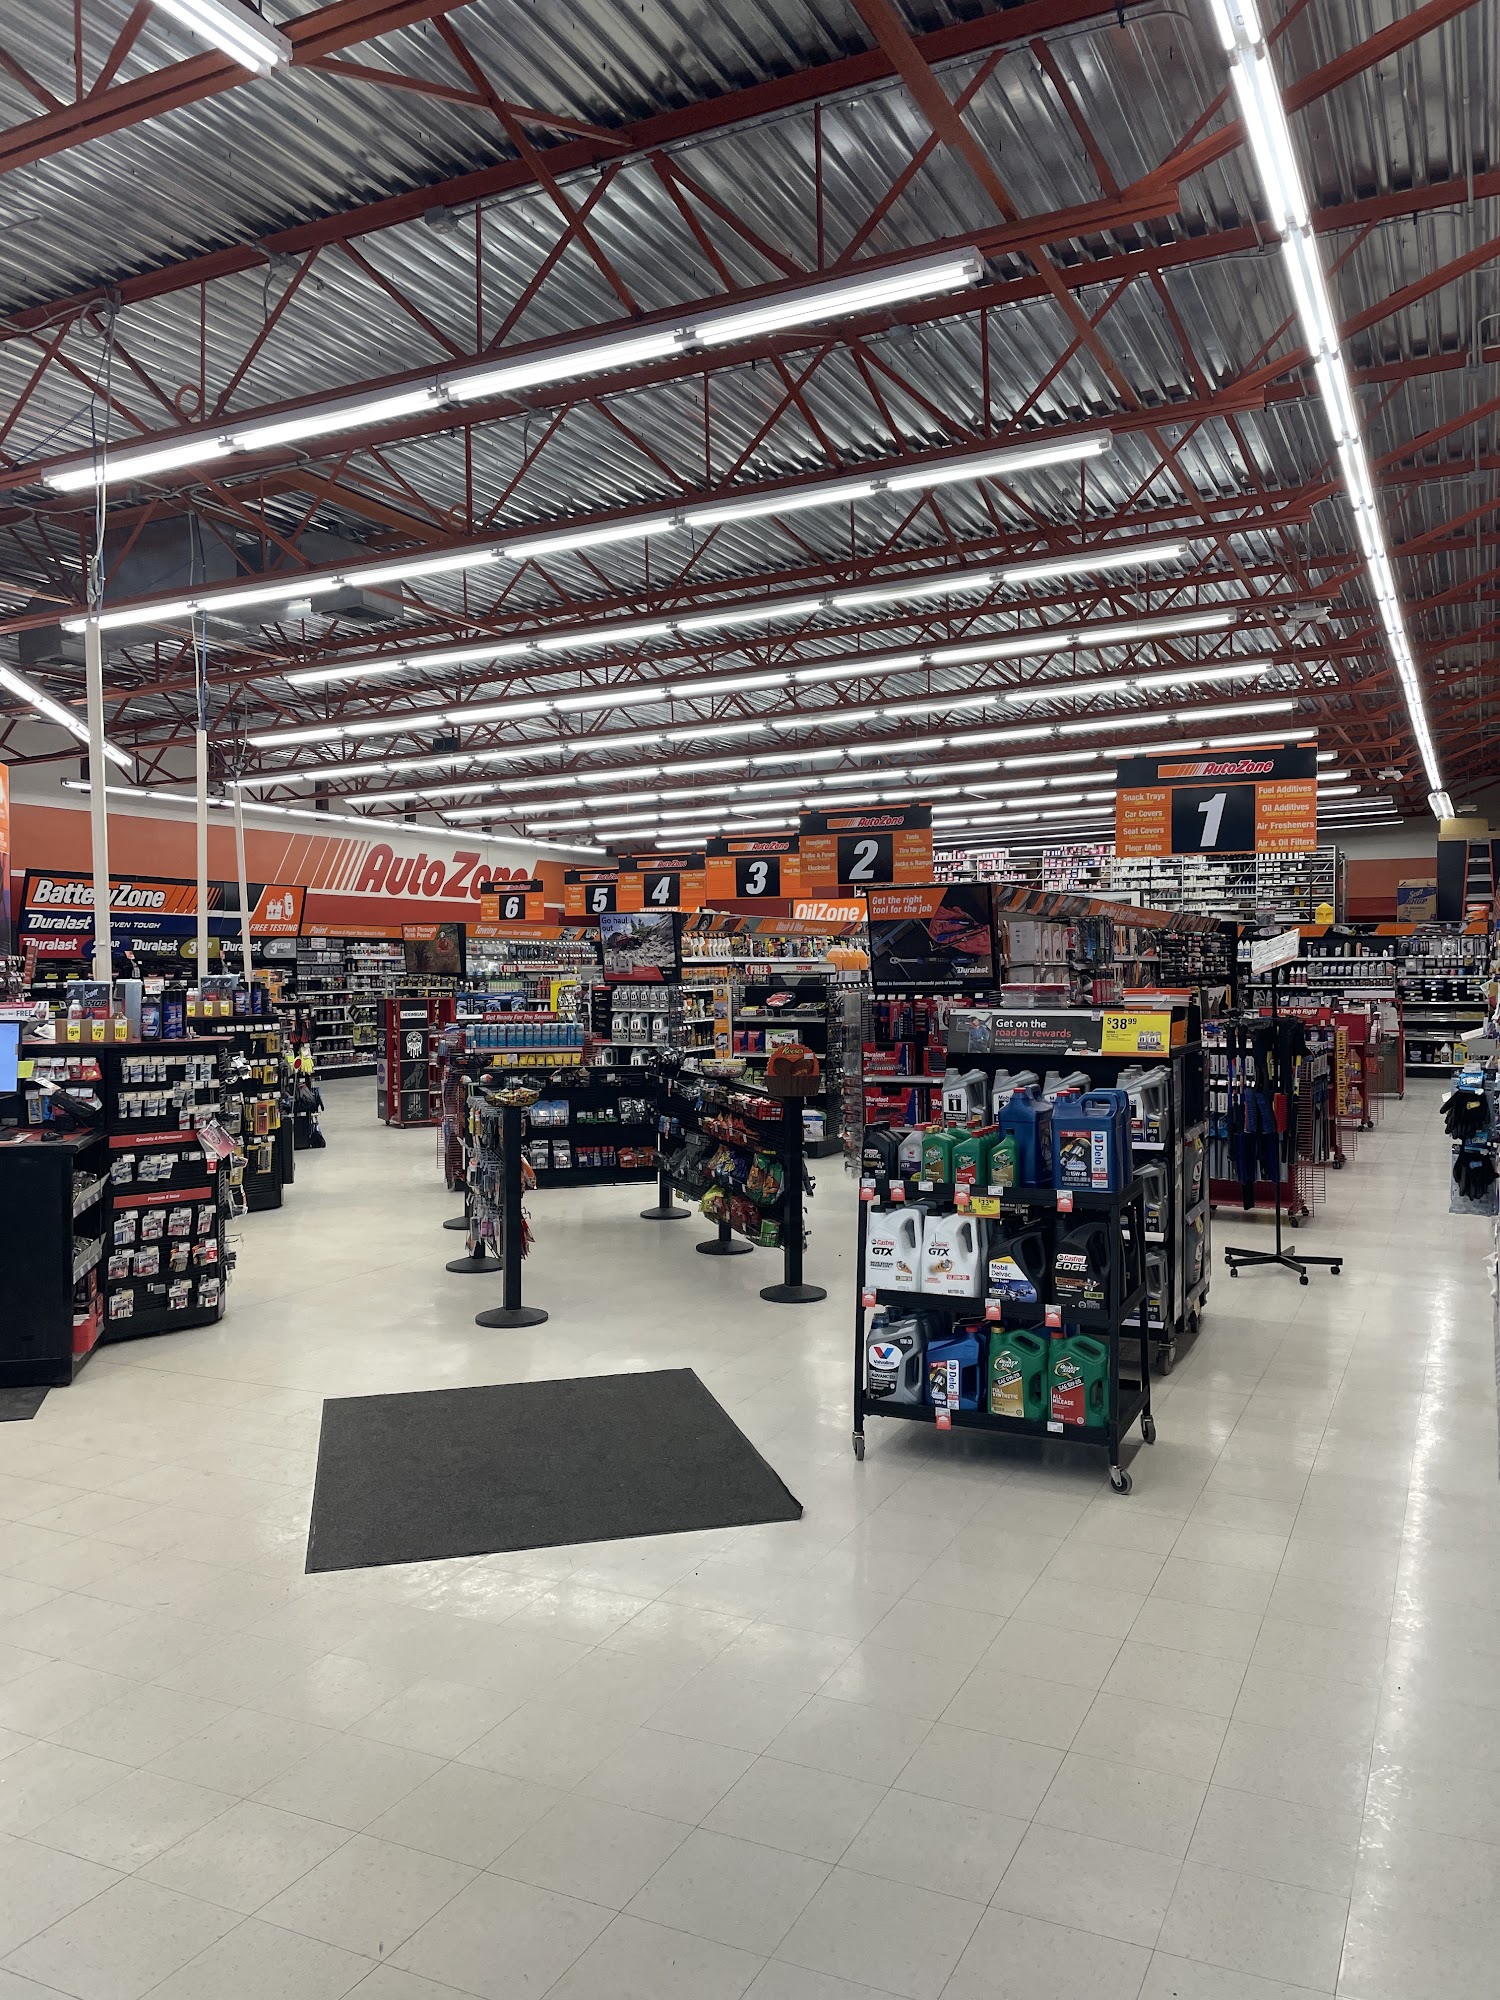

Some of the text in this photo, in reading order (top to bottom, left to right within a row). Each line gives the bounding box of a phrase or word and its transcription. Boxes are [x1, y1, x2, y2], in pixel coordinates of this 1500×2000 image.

[1203, 760, 1274, 776] AutoZone
[1258, 785, 1312, 794] Fuel Additives
[1146, 793, 1166, 801] Trays
[1262, 803, 1309, 812] Oil Additives
[1125, 810, 1137, 818] Car
[858, 815, 904, 827] AutoZone
[1198, 793, 1226, 847] 1
[1257, 821, 1314, 830] Air Fresheners
[1123, 827, 1164, 835] Seat Covers
[752, 842, 789, 850] AutoZone
[1125, 843, 1162, 852] Floor Mats
[1257, 839, 1269, 847] Air
[1278, 838, 1289, 846] Oil
[1291, 838, 1315, 846] Filters
[849, 840, 879, 880] 2
[746, 861, 768, 894] 3
[33, 880, 165, 908] BatteyZone
[652, 877, 670, 904] 4
[592, 888, 608, 912] 5
[872, 895, 922, 906] Get the right
[505, 896, 519, 918] 6
[795, 903, 860, 921] OilZone
[873, 904, 932, 915] tool for the job
[28, 914, 92, 929] Duralast
[615, 916, 628, 924] haul
[250, 923, 298, 931] FREE TESTING
[309, 926, 328, 935] Paint
[475, 925, 497, 936] Towing
[23, 938, 78, 951] Duralast
[131, 939, 178, 951] Duralast
[188, 942, 197, 954] 3
[221, 941, 261, 951] Duraast
[270, 943, 277, 954] 3
[504, 964, 516, 972] FREE
[750, 965, 768, 974] FREE
[956, 966, 989, 977] Duralast
[996, 1019, 1014, 1028] Get
[1030, 1019, 1047, 1028] the
[995, 1028, 1072, 1038] road to rewards
[951, 1100, 957, 1110] 1
[1095, 1145, 1103, 1165] Delo
[872, 1248, 893, 1256] GTX
[929, 1248, 950, 1256] GTX
[1064, 1255, 1085, 1263] Castrol
[991, 1263, 1008, 1271] Mobil
[1055, 1262, 1088, 1271] EDGE
[1058, 1384, 1067, 1392] SAE
[992, 1391, 1018, 1400] SYNTHETIC
